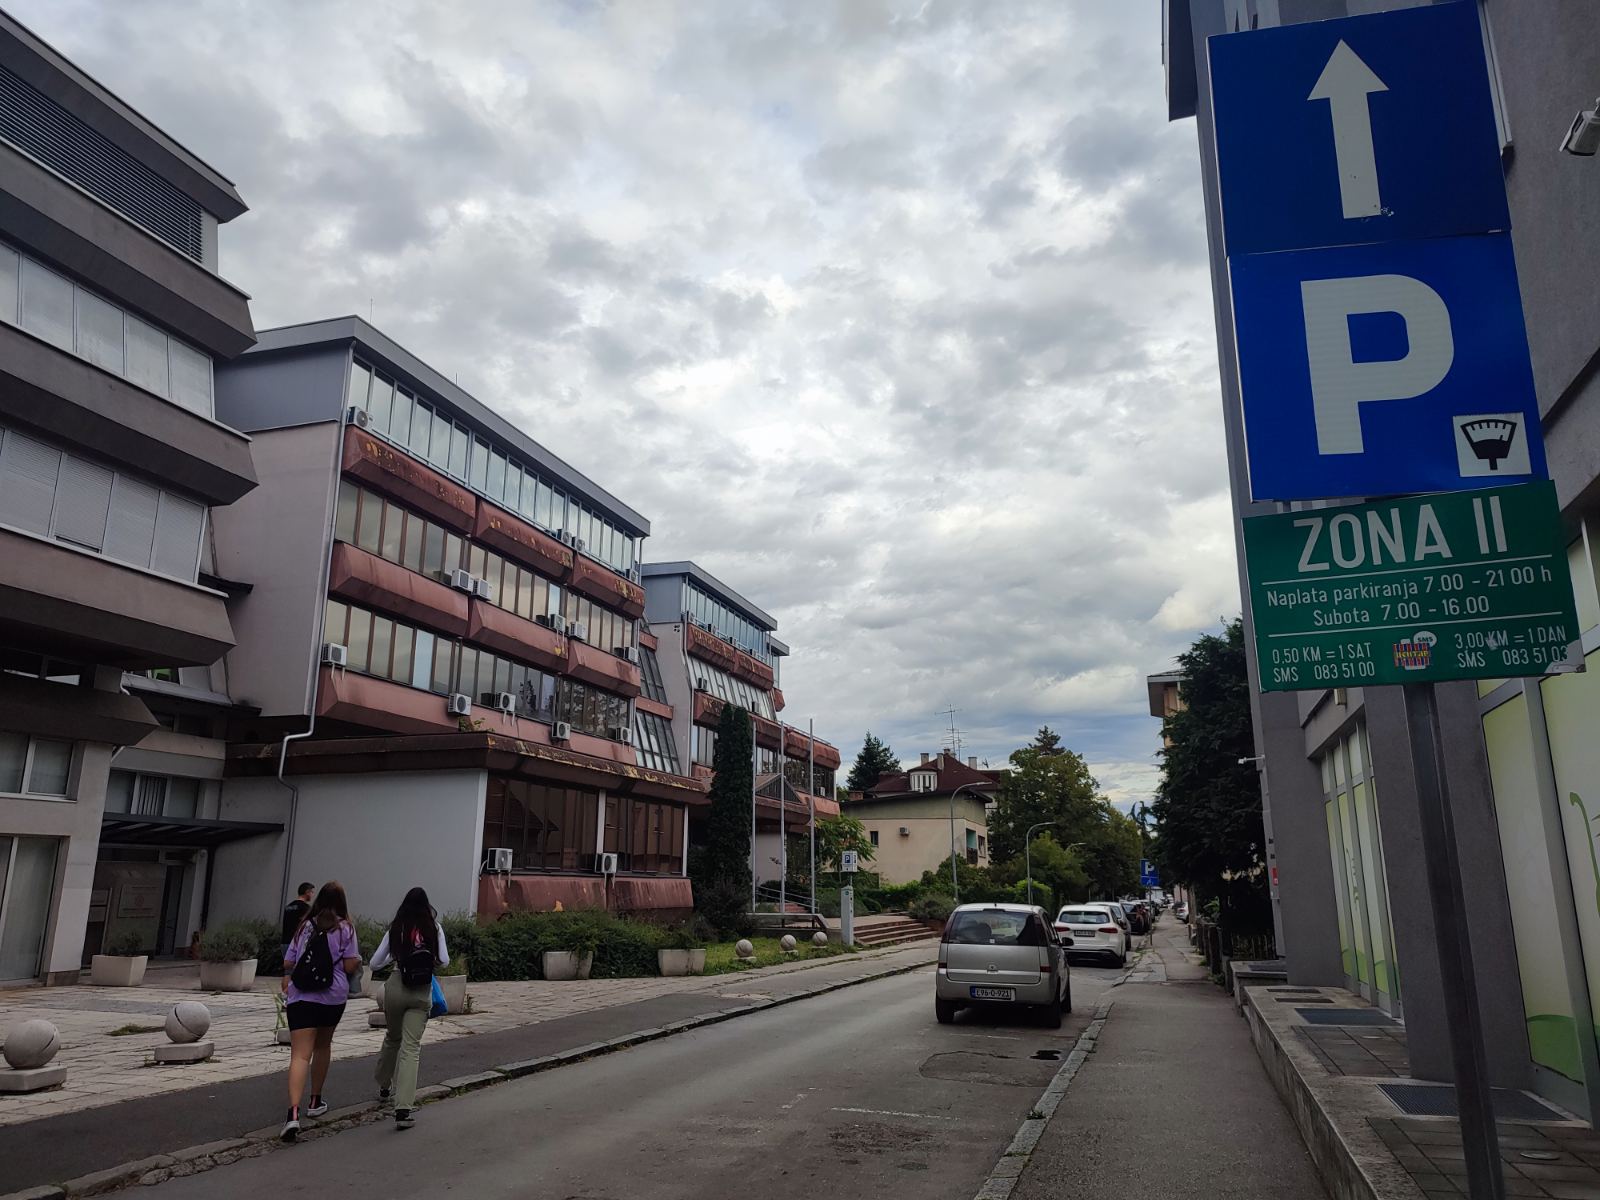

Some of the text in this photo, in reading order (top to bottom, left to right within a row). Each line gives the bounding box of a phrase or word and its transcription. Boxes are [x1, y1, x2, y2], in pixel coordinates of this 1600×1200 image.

[1300, 274, 1454, 455] P
[1294, 495, 1508, 573] ZONA II
[1267, 588, 1328, 609] Naplata
[1333, 582, 1418, 606] parkiranja
[1423, 573, 1464, 593] 7.00
[1540, 564, 1552, 582] h
[1313, 608, 1370, 627] Subota
[1381, 601, 1420, 621] 7.00
[1442, 595, 1490, 616] 16.00
[1486, 630, 1509, 647] KM
[1537, 626, 1566, 643] DAN
[1272, 648, 1299, 664] 0.50
[1303, 646, 1321, 662] KM
[1347, 642, 1371, 659] SAT
[1457, 650, 1486, 668] SMS
[1502, 648, 1529, 665] 083
[1533, 647, 1547, 664] 51
[1273, 661, 1375, 683] SMS 083 51 00
[1144, 861, 1155, 875] P
